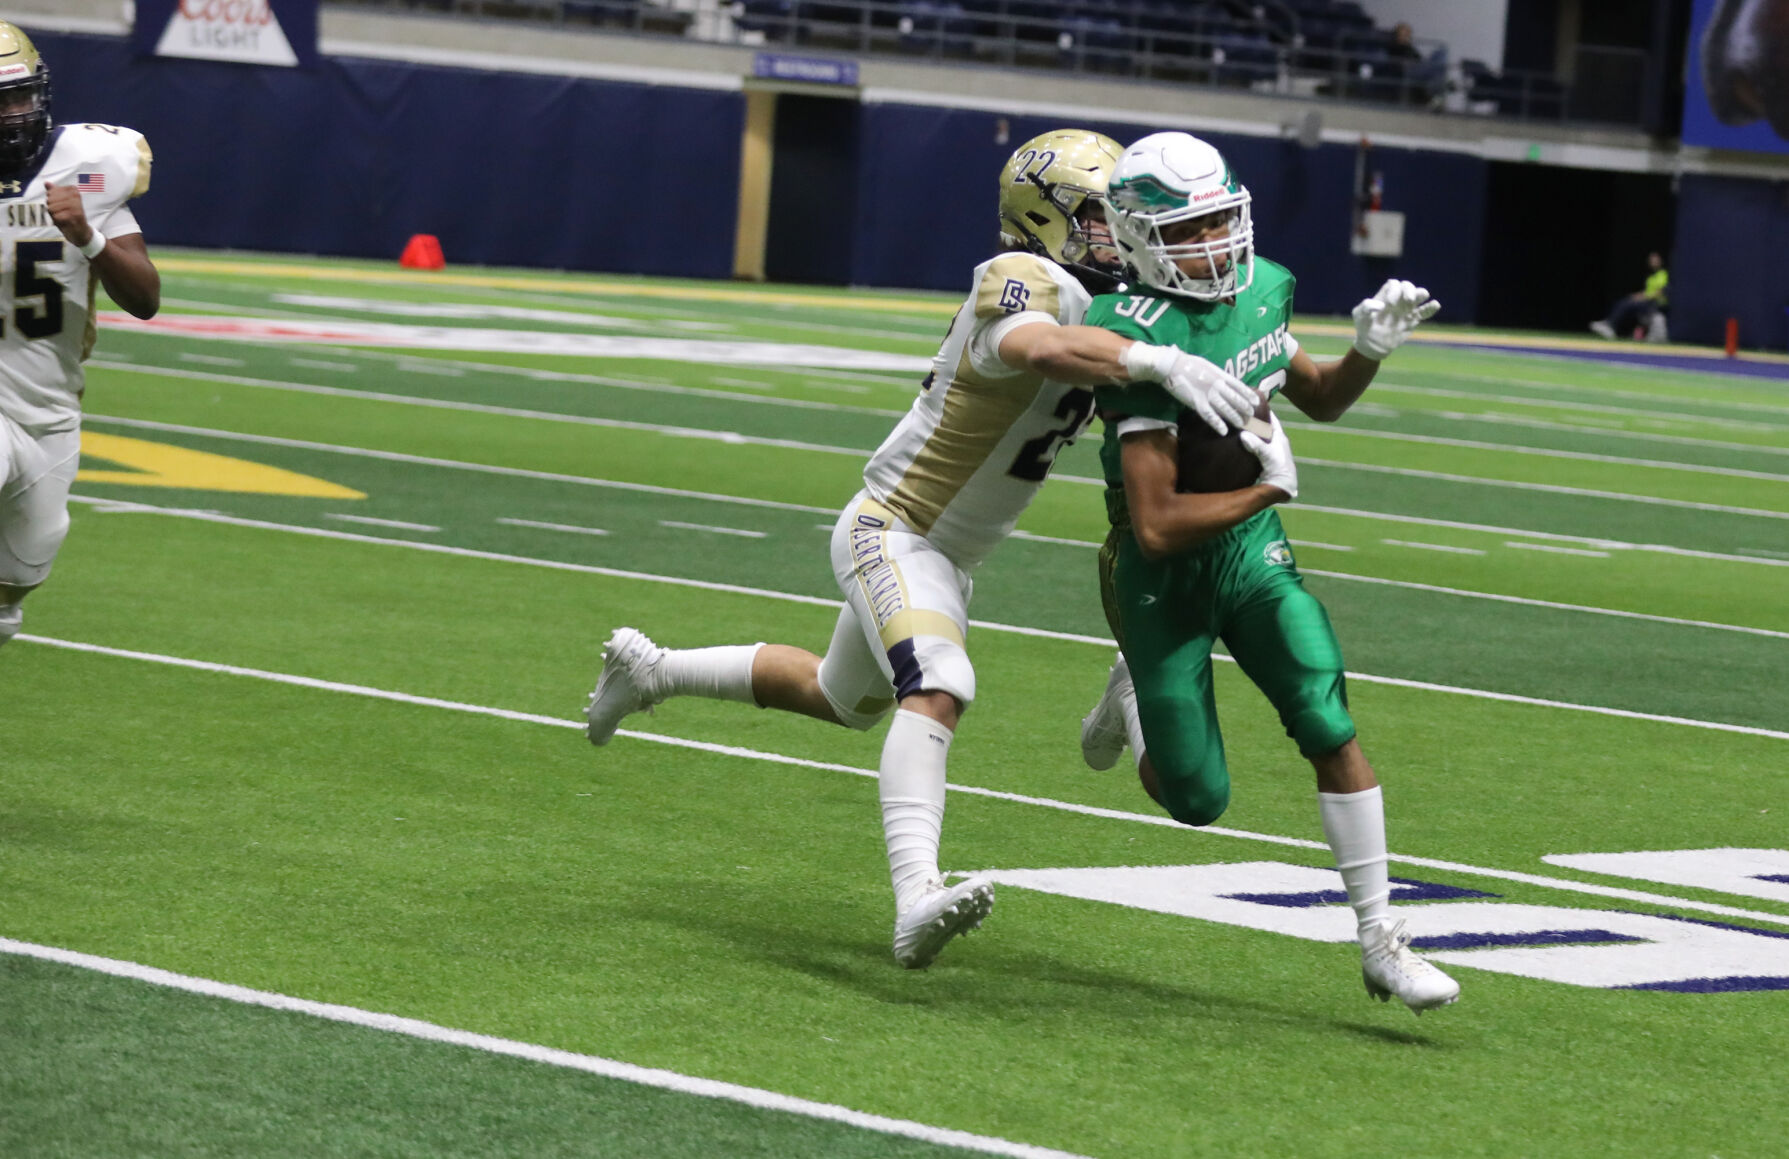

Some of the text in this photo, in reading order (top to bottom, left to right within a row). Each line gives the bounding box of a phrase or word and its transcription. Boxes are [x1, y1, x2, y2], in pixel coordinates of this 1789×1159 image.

[1014, 150, 1056, 185] 22
[1193, 187, 1225, 202] Riddell
[8, 203, 48, 227] SUNR
[0, 237, 67, 341] 5
[1224, 322, 1287, 381] AGSTAF
[1006, 385, 1096, 483] 2
[854, 514, 886, 570] DSERT
